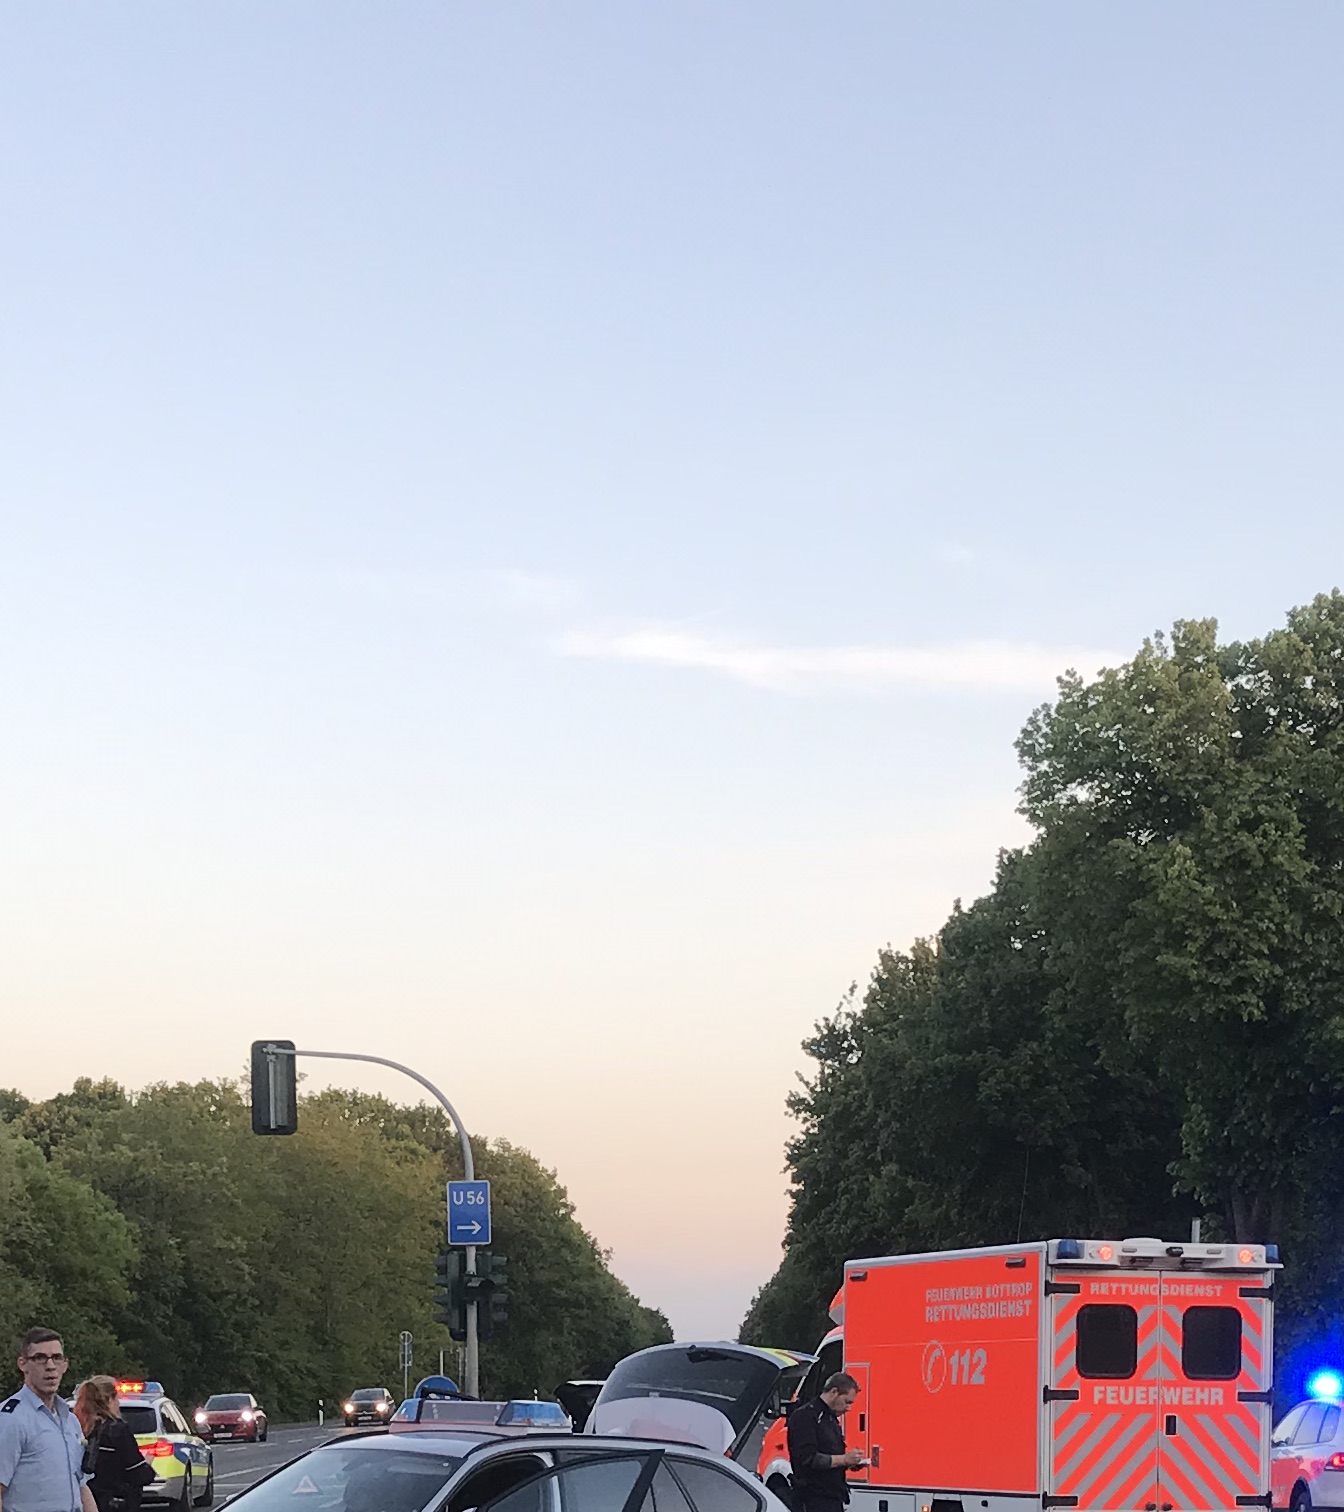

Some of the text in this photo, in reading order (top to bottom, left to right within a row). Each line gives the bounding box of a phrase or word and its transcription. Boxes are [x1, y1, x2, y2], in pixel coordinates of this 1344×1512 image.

[926, 1282, 1033, 1302] FEUERWEHR BOTTROP
[1090, 1282, 1224, 1297] RETTUNGSDIENST
[926, 1299, 1033, 1323] RETTUNGSDIENST
[949, 1348, 988, 1385] 112
[1093, 1385, 1224, 1406] FEUERWEHR
